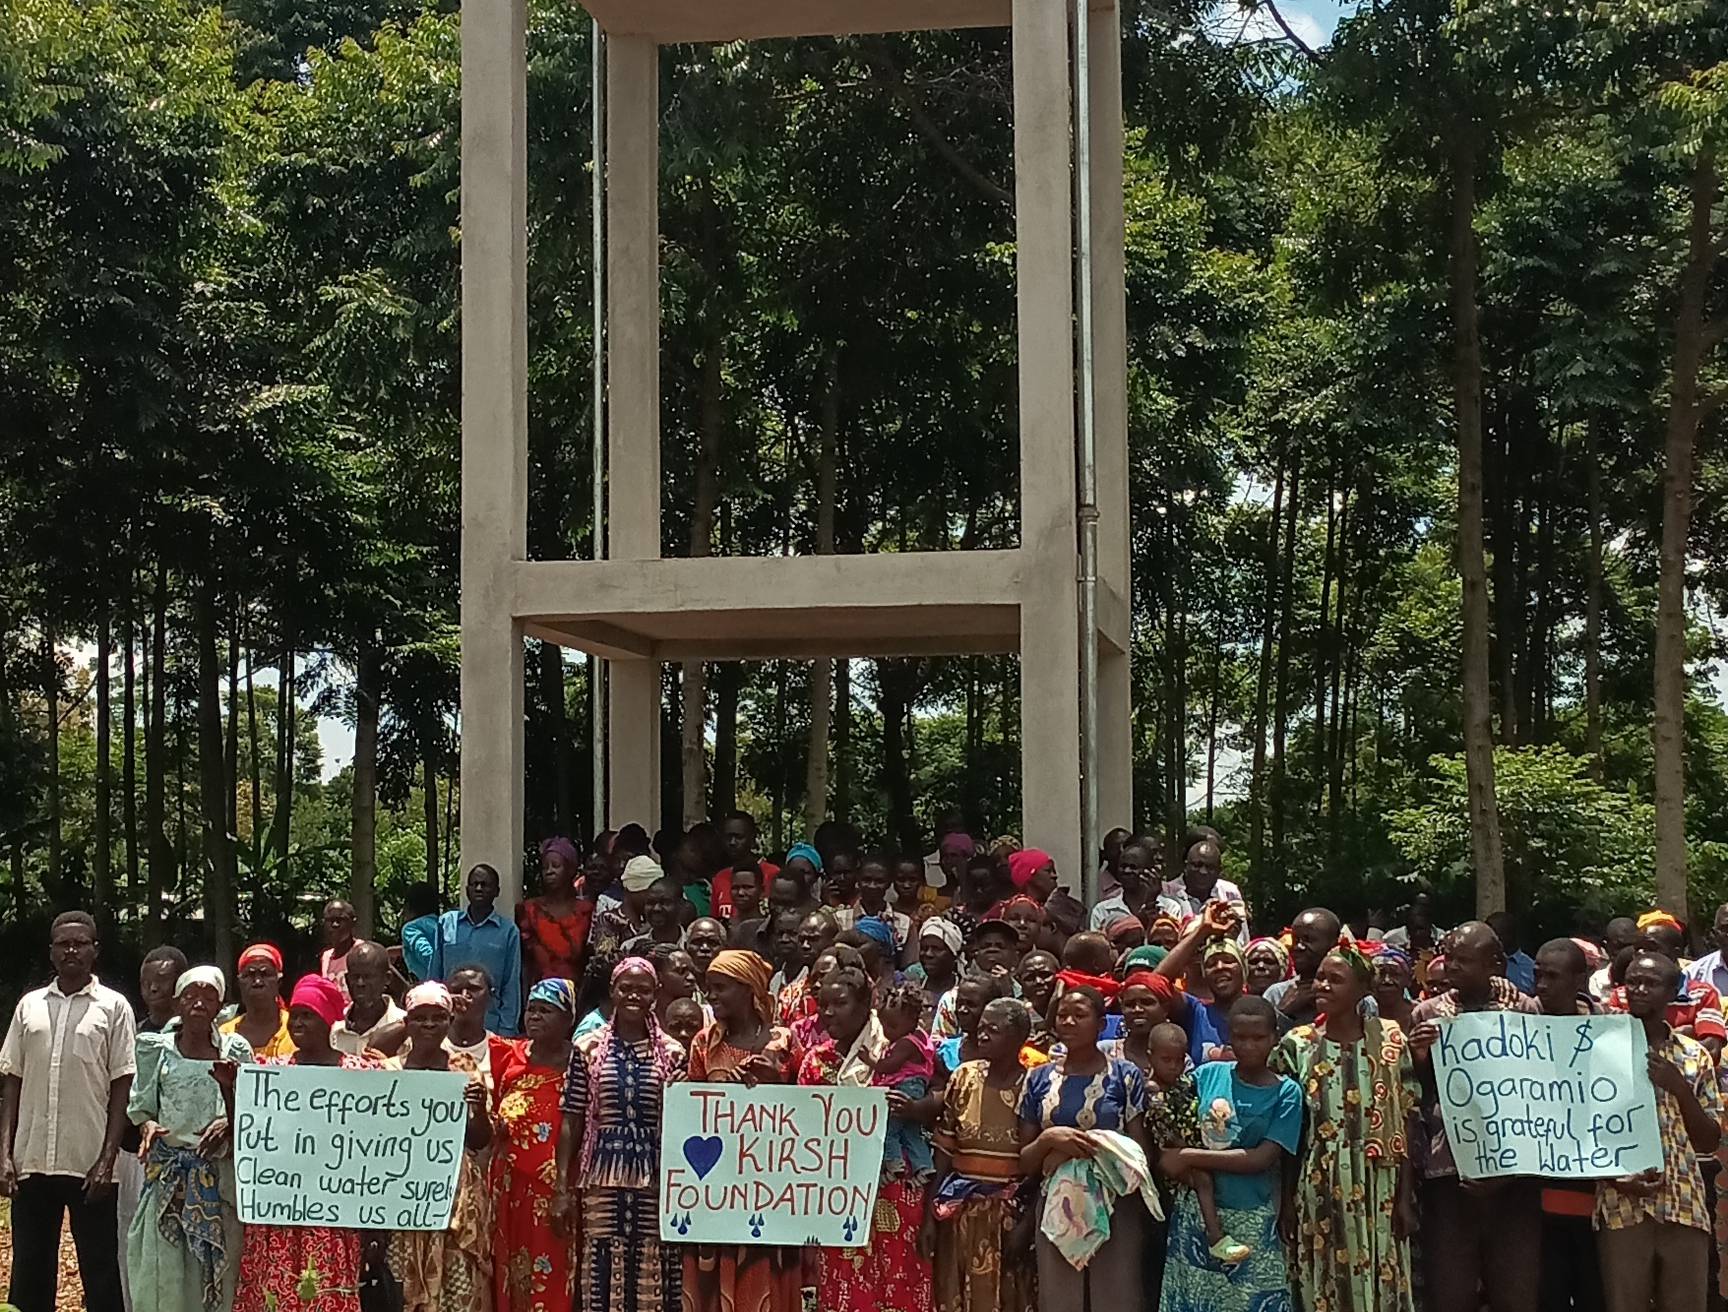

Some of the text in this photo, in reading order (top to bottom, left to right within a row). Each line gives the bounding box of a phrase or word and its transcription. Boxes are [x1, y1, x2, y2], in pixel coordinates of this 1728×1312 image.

[244, 1069, 464, 1136] The efforts you
[690, 1091, 878, 1136] THANK YOU
[1446, 1068, 1618, 1119] Ogaramio
[237, 1113, 454, 1178] Put in giving us
[1453, 1103, 1645, 1153] is grateful for
[236, 1156, 301, 1189] Clean
[319, 1165, 398, 1196] water
[738, 1133, 849, 1180] KIRSH
[1475, 1140, 1639, 1174] the Water
[240, 1189, 340, 1223] Humbles
[359, 1204, 386, 1225] us
[665, 1169, 872, 1221] FOUNDATION
